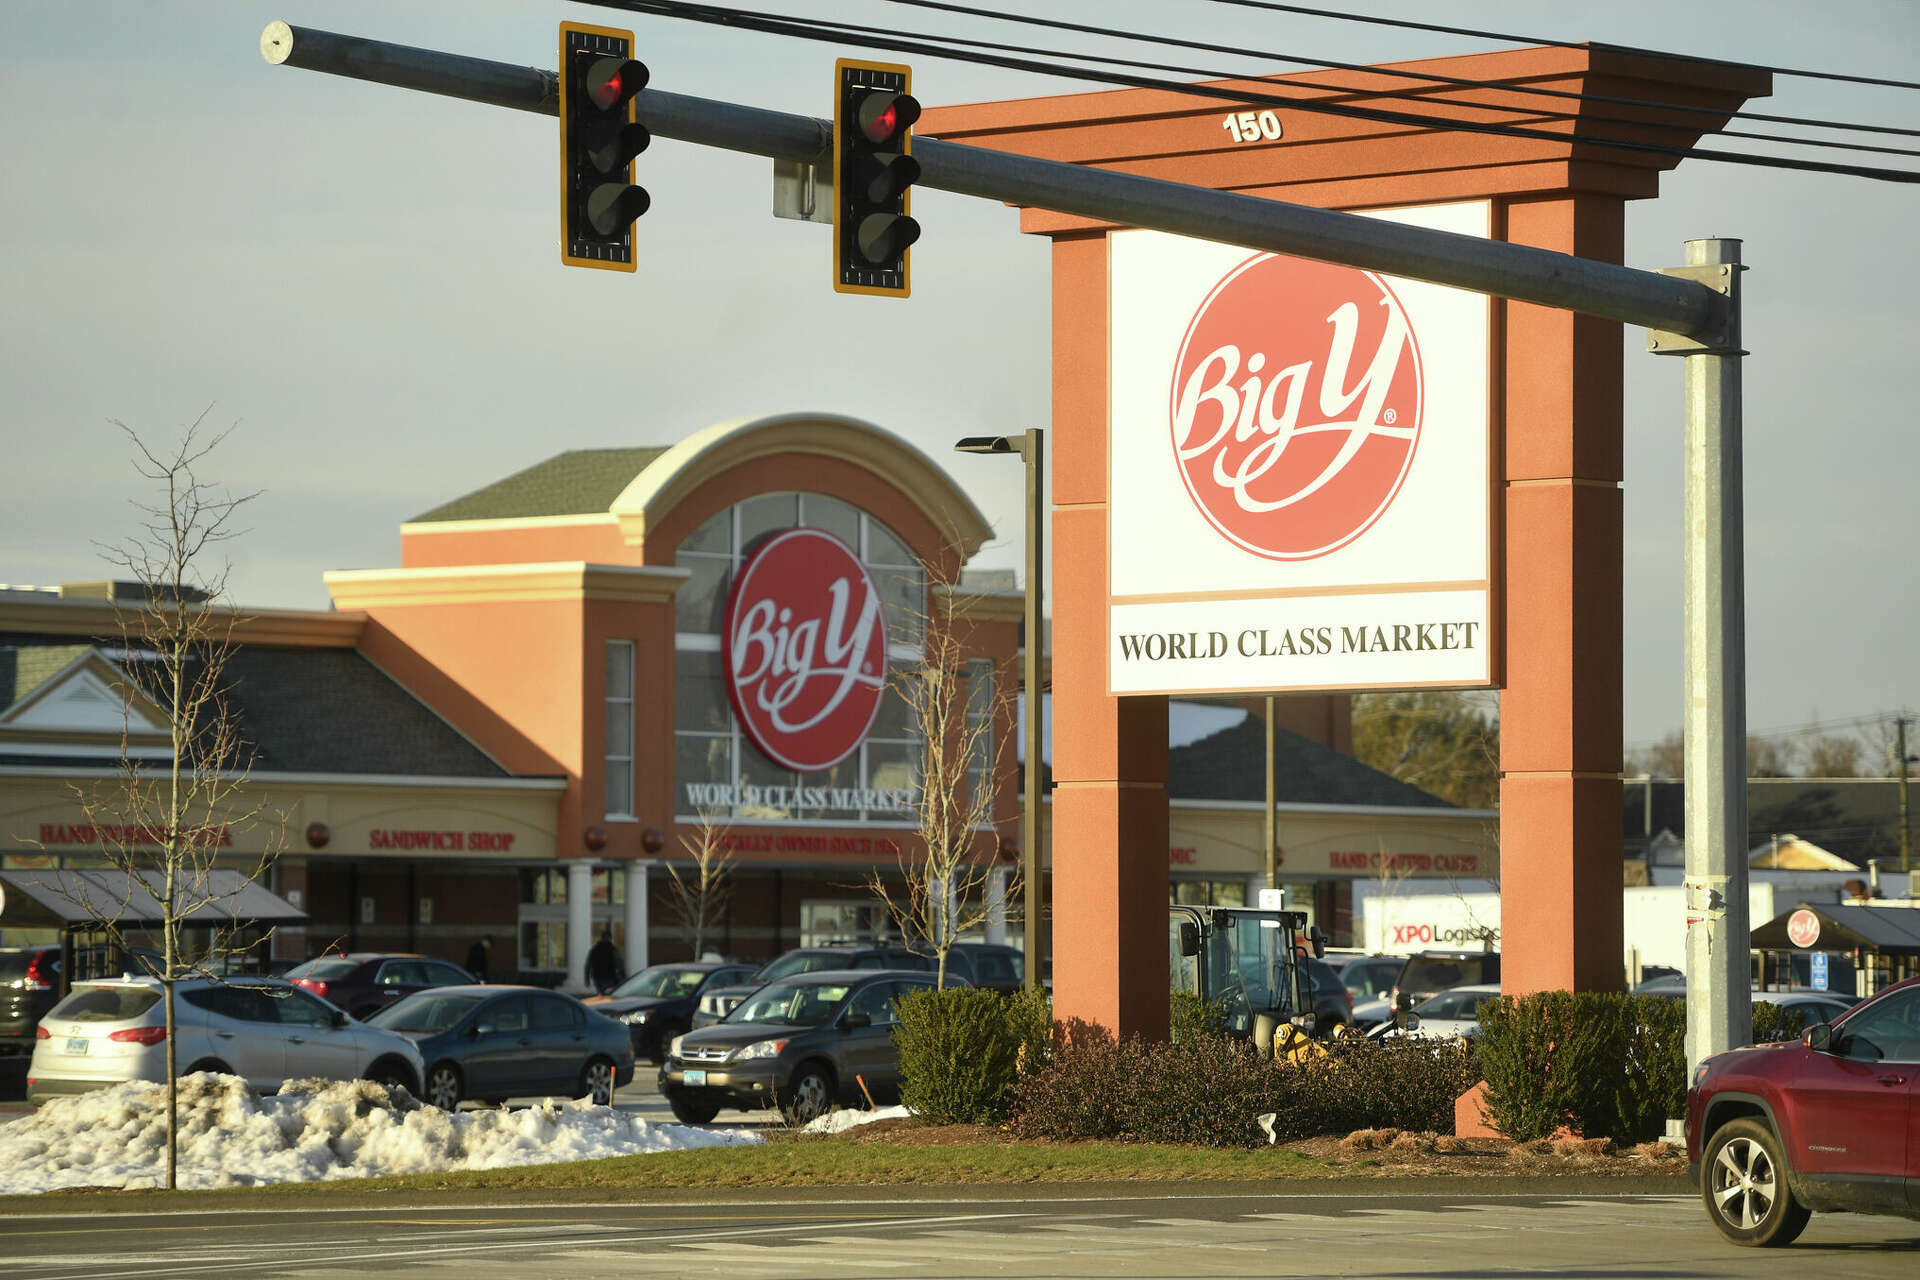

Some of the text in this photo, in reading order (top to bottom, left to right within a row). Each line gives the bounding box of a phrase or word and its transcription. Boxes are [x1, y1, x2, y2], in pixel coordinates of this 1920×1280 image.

[1222, 110, 1282, 143] 150
[1174, 344, 1313, 488] Big
[735, 597, 822, 712] Big
[1118, 621, 1479, 662] WORLD CLASS MARKET
[685, 783, 916, 811] WORLD CLASS MARKET
[40, 823, 97, 844] HAND
[369, 829, 516, 851] SANDWICH SHOP
[831, 836, 871, 853] SINCE
[1393, 924, 1432, 944] XPO
